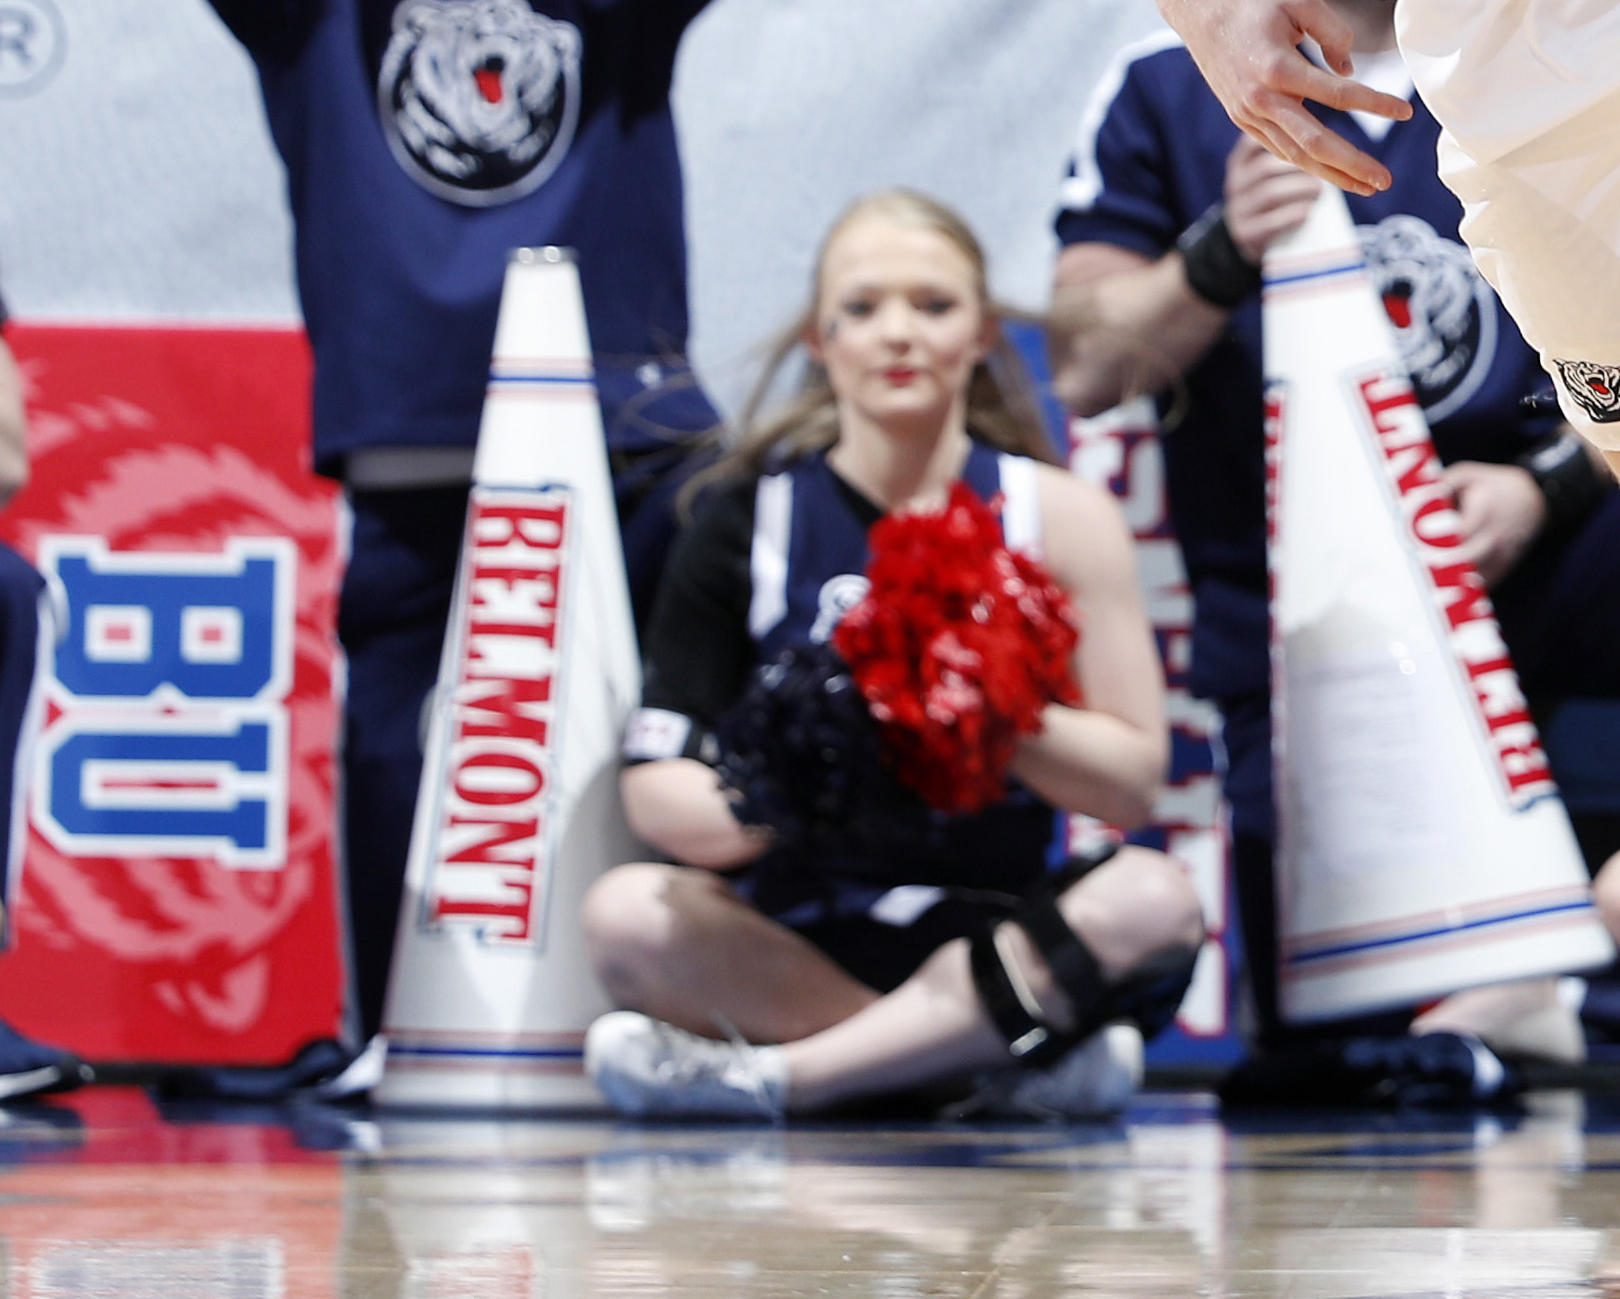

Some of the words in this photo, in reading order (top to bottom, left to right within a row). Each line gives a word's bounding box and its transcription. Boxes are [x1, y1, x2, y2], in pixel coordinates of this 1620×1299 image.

[36, 537, 297, 867] BU
[430, 499, 569, 942] BELMONT
[1359, 371, 1558, 800] BELMONT
